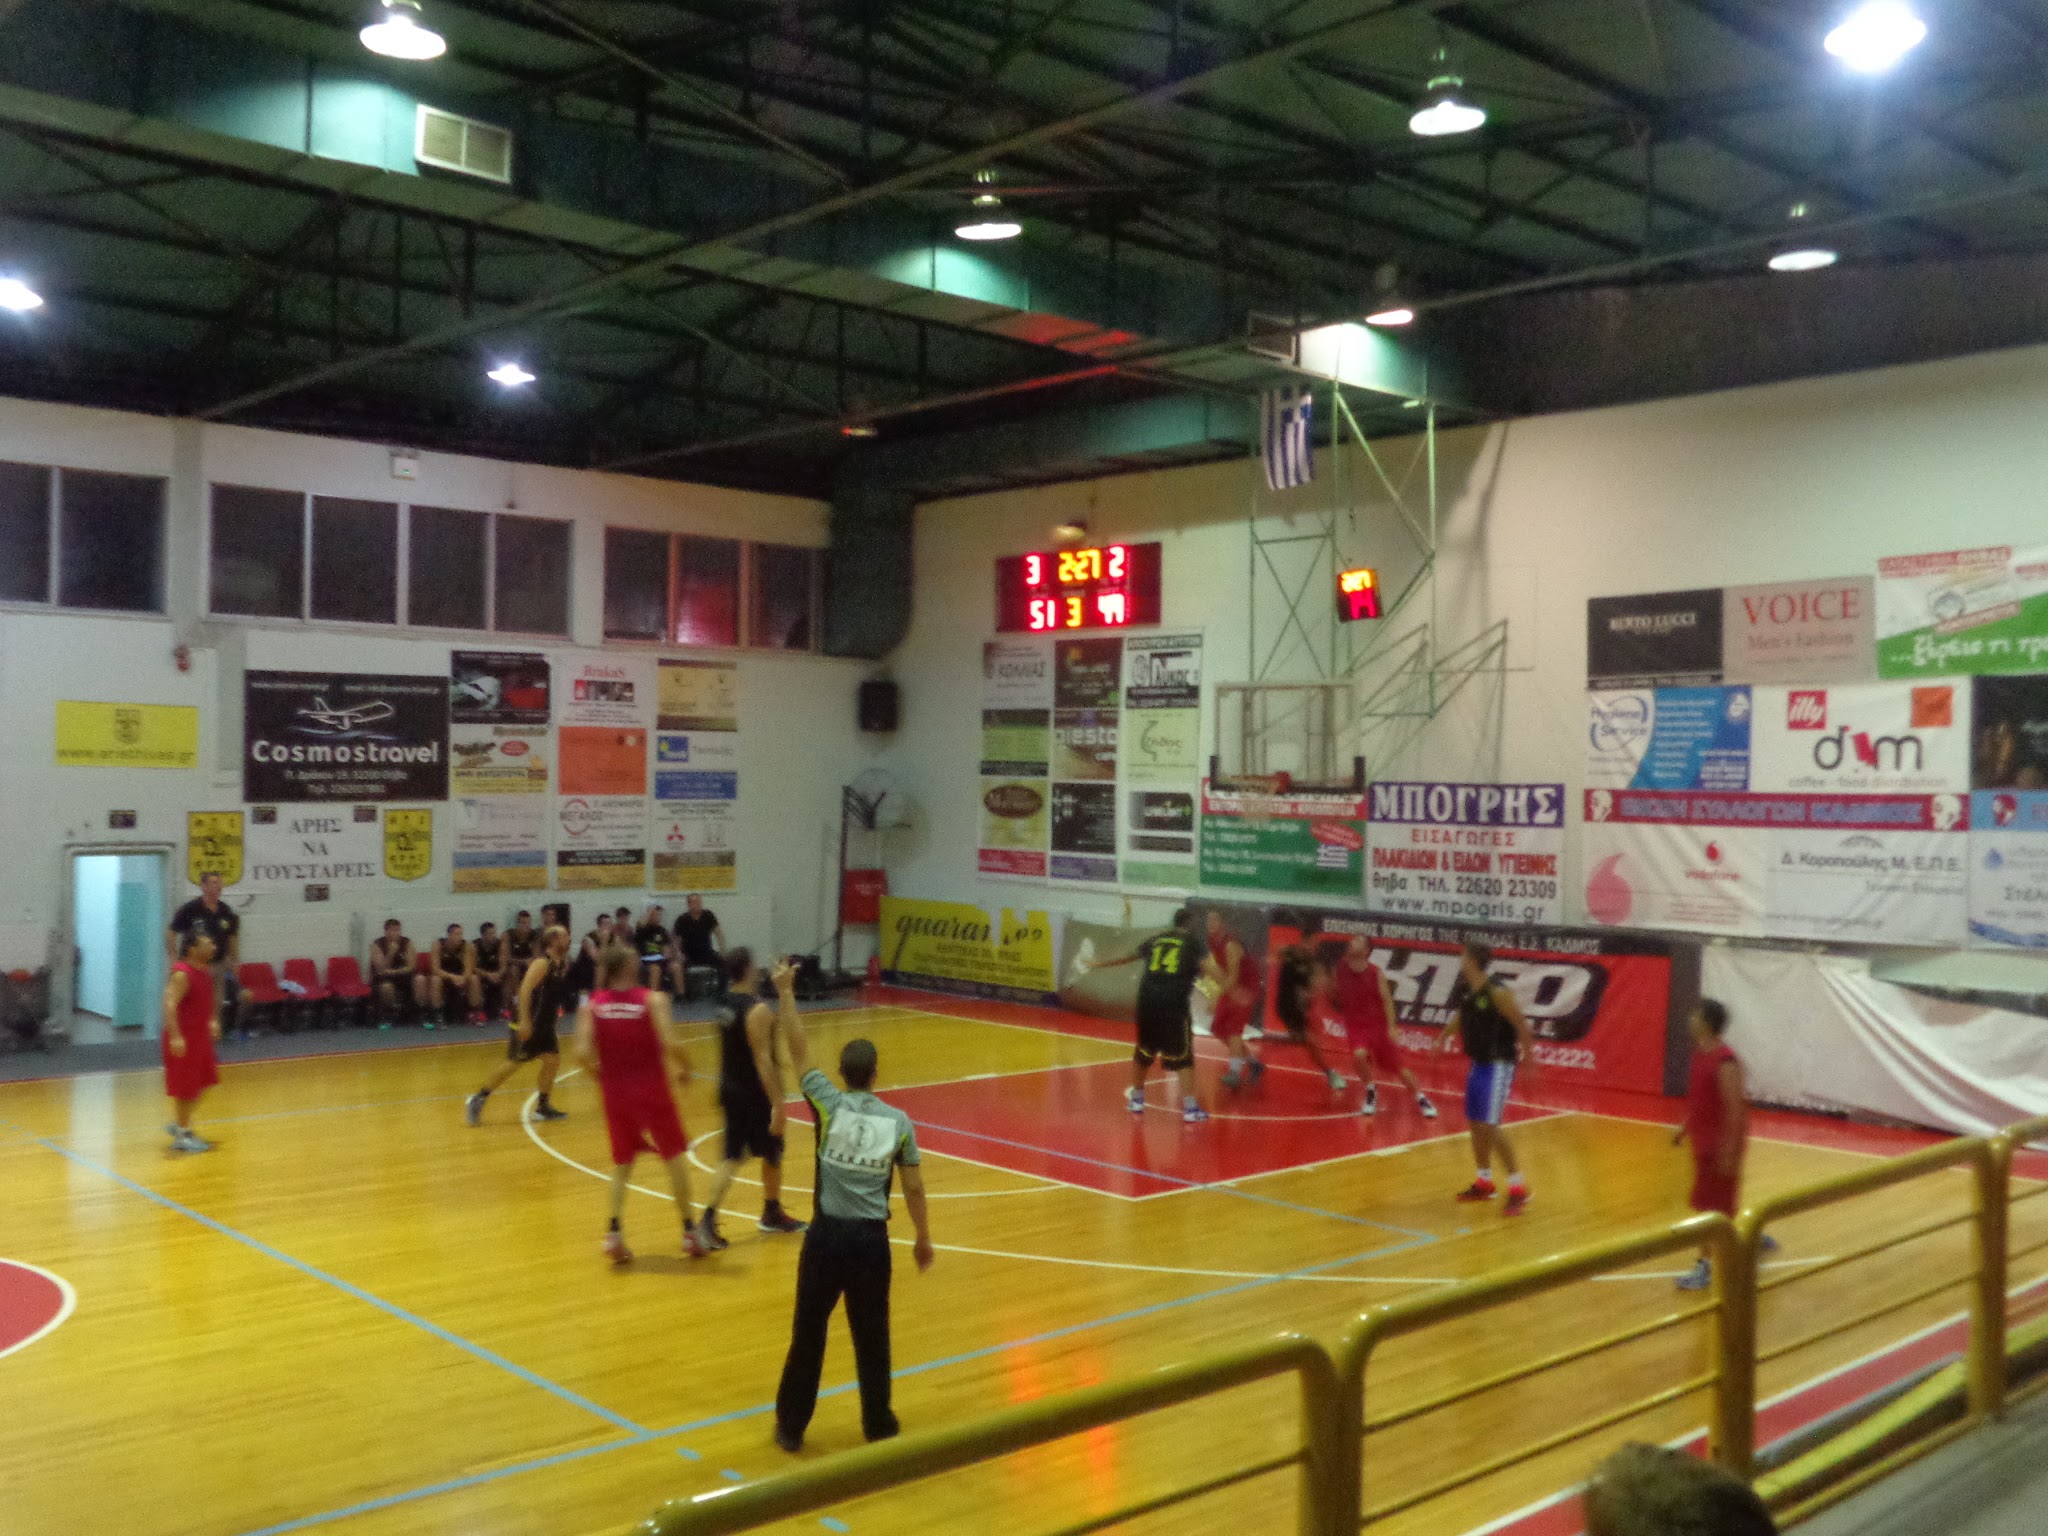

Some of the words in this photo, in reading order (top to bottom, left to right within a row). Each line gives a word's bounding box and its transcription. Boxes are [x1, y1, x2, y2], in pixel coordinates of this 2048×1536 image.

[1025, 555, 1041, 585] 3
[1066, 596, 1081, 628] 3
[1743, 588, 1862, 624] VOICE
[252, 739, 440, 764] Cosmostravel
[1373, 784, 1557, 824] ΜΠΟΓΡΗΣ
[289, 818, 342, 833] ΑΡΗΣ
[1411, 828, 1516, 847] ΕΙΣΑΓΩΓΕΣ
[303, 841, 329, 856] ΝΑ
[252, 862, 377, 881] ΓΟΥΣΤΑΡΕΙΣ
[1455, 876, 1503, 896] 22620
[1507, 879, 1557, 899] 23309
[1381, 896, 1546, 924] www.mpogris.gr
[1149, 945, 1180, 975] 14
